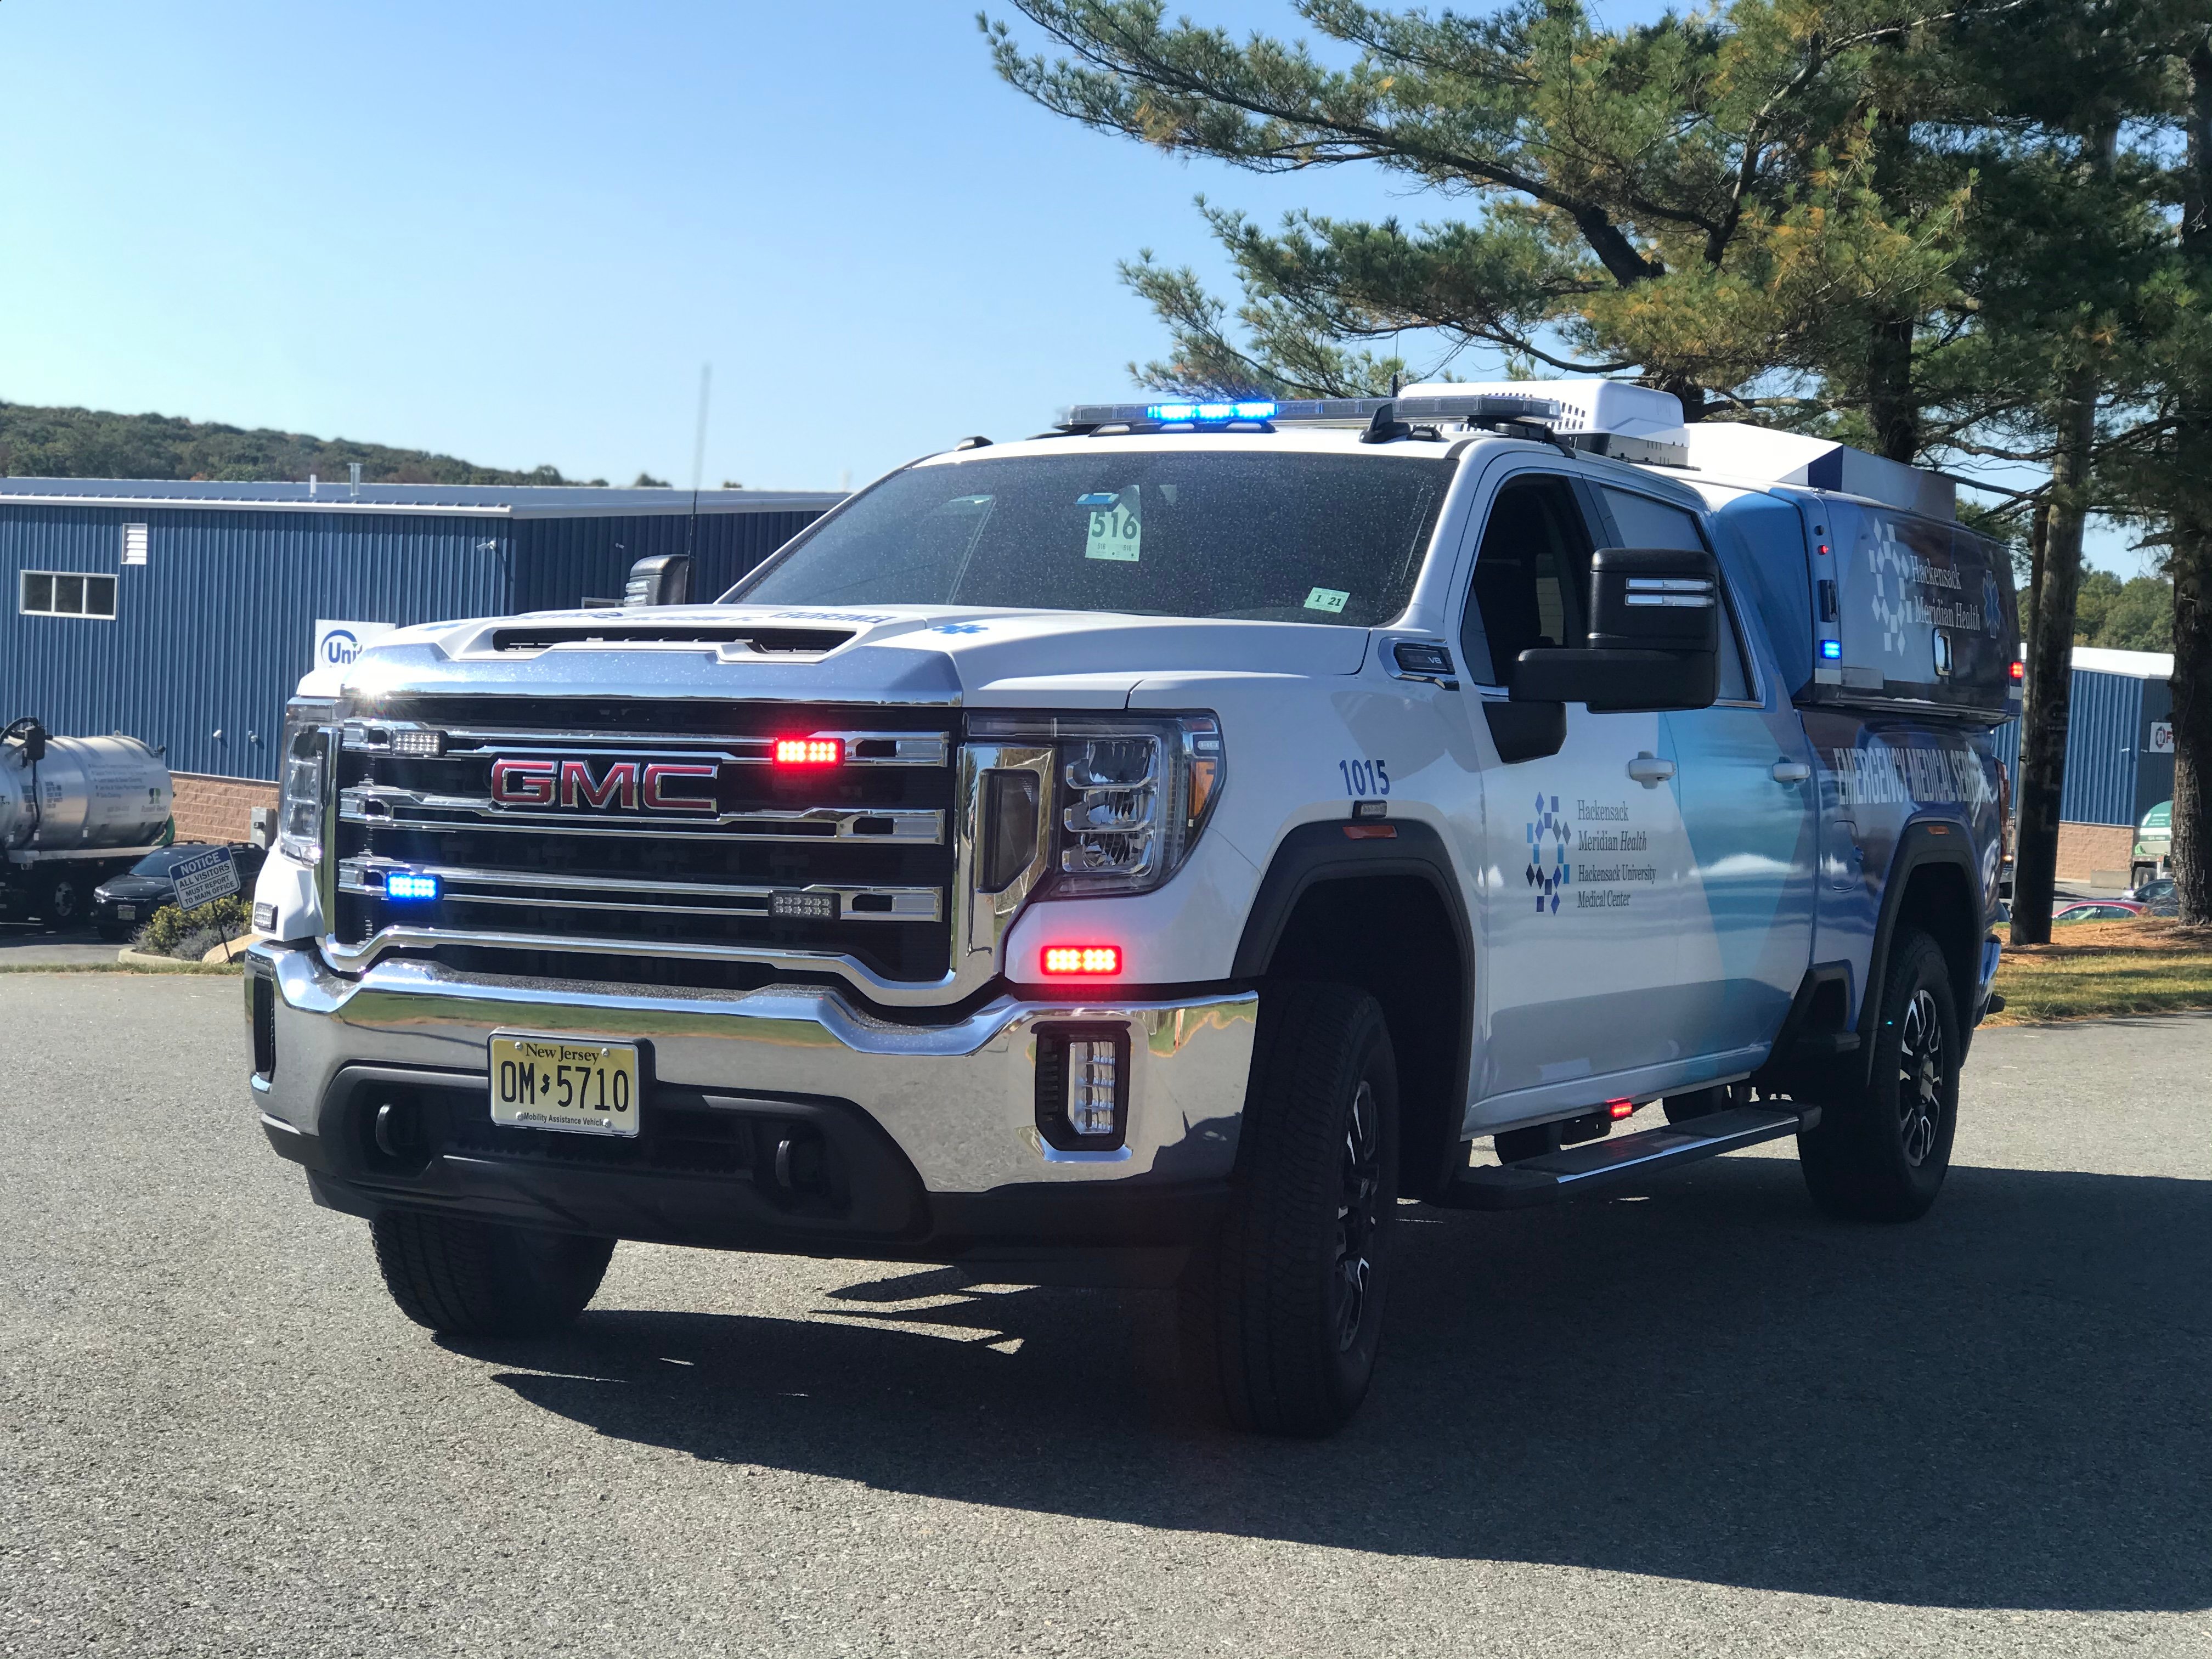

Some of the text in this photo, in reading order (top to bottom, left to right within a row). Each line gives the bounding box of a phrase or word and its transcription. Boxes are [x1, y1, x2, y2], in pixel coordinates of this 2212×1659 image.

[1091, 511, 1137, 540] 516
[1910, 555, 1962, 590] Hackensack
[1328, 597, 1342, 606] 21
[1914, 595, 1980, 631] Meridian Health
[491, 758, 720, 811] GMC
[1339, 759, 1390, 795] 1015
[1833, 747, 1910, 805] EMERGENCY
[1906, 748, 1956, 802] MEDICAL
[1577, 799, 1629, 821] Hackensack
[1578, 830, 1647, 851] Meridian Health
[180, 851, 221, 876] NOTICE
[1578, 864, 1657, 884] Hackensack University
[179, 863, 229, 888] ALL VISITORS
[185, 875, 229, 897] MUST REPORT
[194, 890, 211, 900] MAIN
[212, 881, 235, 894] OFFICE
[1577, 890, 1631, 908] Medical Center
[525, 1043, 600, 1065] New Jersey
[500, 1060, 629, 1113] OM 5710
[523, 1112, 547, 1123] Mobility
[549, 1114, 581, 1125] Assistance
